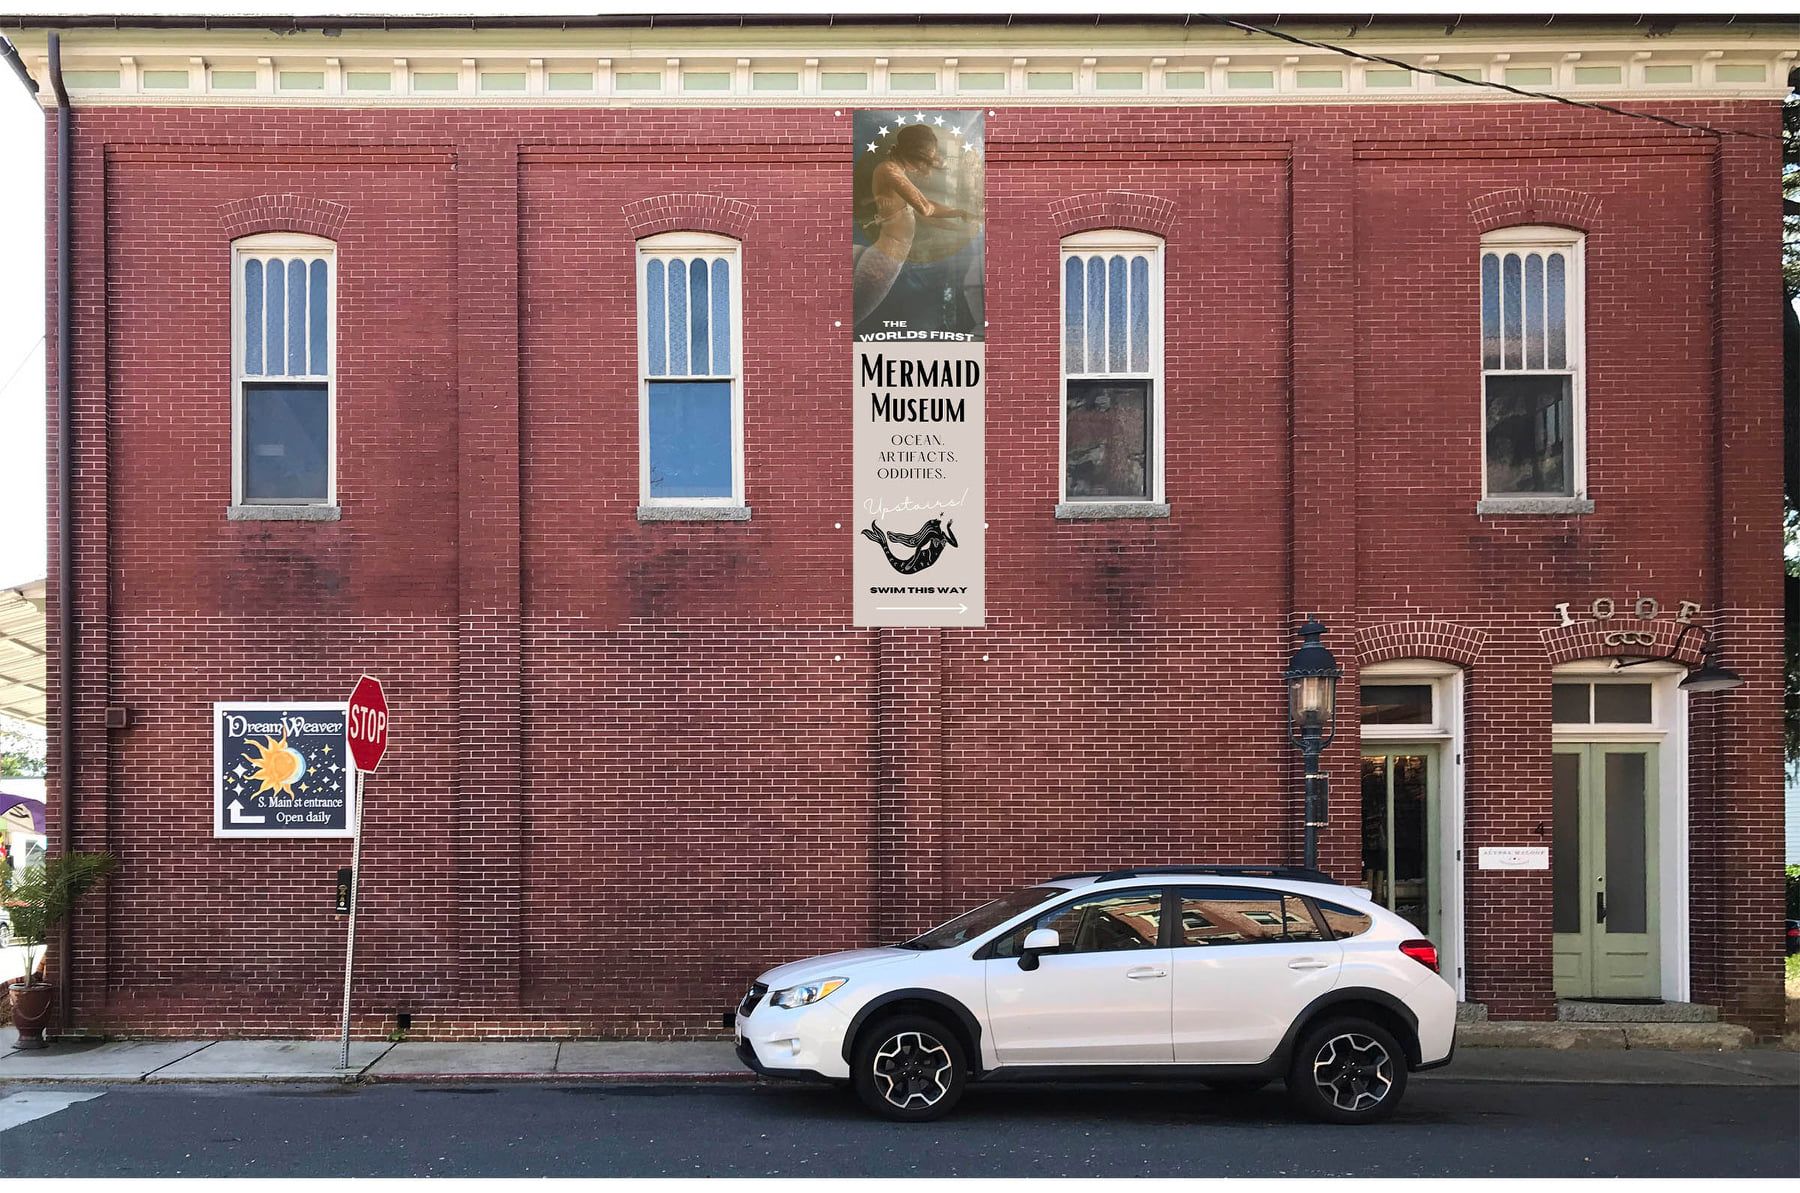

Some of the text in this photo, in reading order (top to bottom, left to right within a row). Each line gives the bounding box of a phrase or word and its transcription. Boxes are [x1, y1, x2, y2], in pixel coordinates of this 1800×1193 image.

[882, 320, 907, 328] THE
[859, 330, 974, 342] WORLDS FIRST
[861, 353, 980, 387] MERMAID
[871, 392, 965, 422] MUSEUM
[891, 434, 945, 446] OCEAN.
[878, 451, 958, 463] ARTIFACTS.
[877, 468, 946, 480] ODDITIES.
[863, 488, 969, 520] Upstairs!
[869, 586, 968, 594] SWIM THIS WAY
[350, 703, 386, 744] STOP
[257, 797, 343, 808] S. Main st entrance
[276, 811, 332, 825] Open daily
